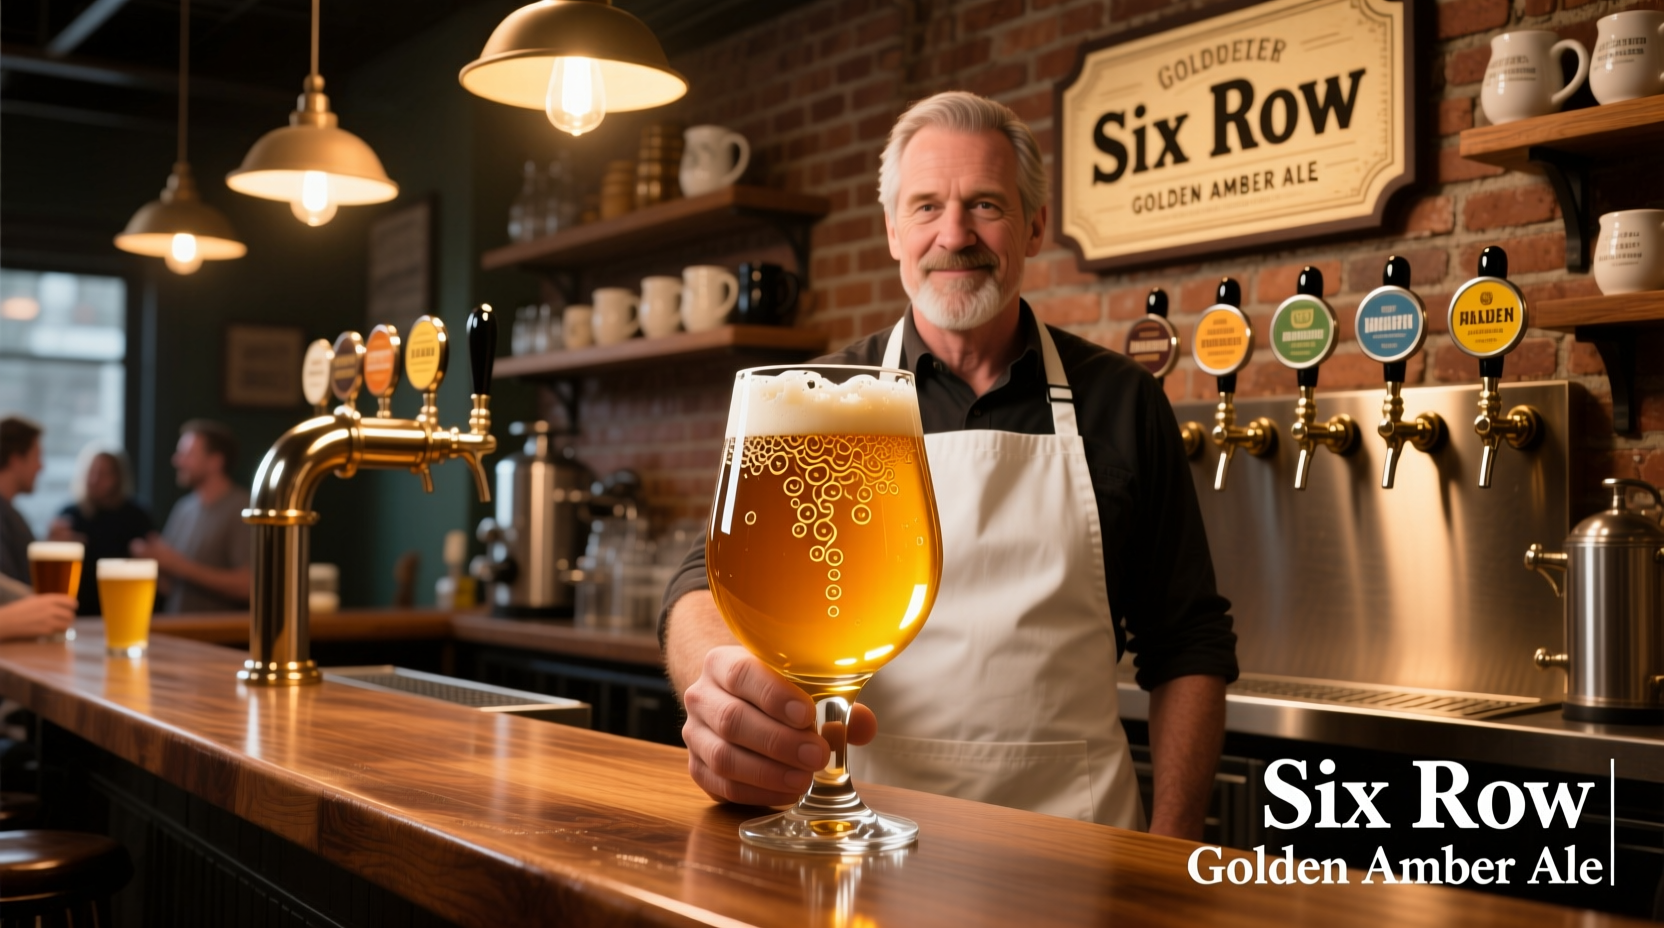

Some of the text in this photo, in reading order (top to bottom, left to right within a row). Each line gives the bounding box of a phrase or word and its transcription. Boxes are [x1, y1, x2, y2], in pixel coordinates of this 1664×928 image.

[1092, 68, 1367, 187] Six Row
[1132, 183, 1202, 215] GOLDEN
[1210, 170, 1275, 200] AMBER
[1283, 161, 1319, 187] ALE
